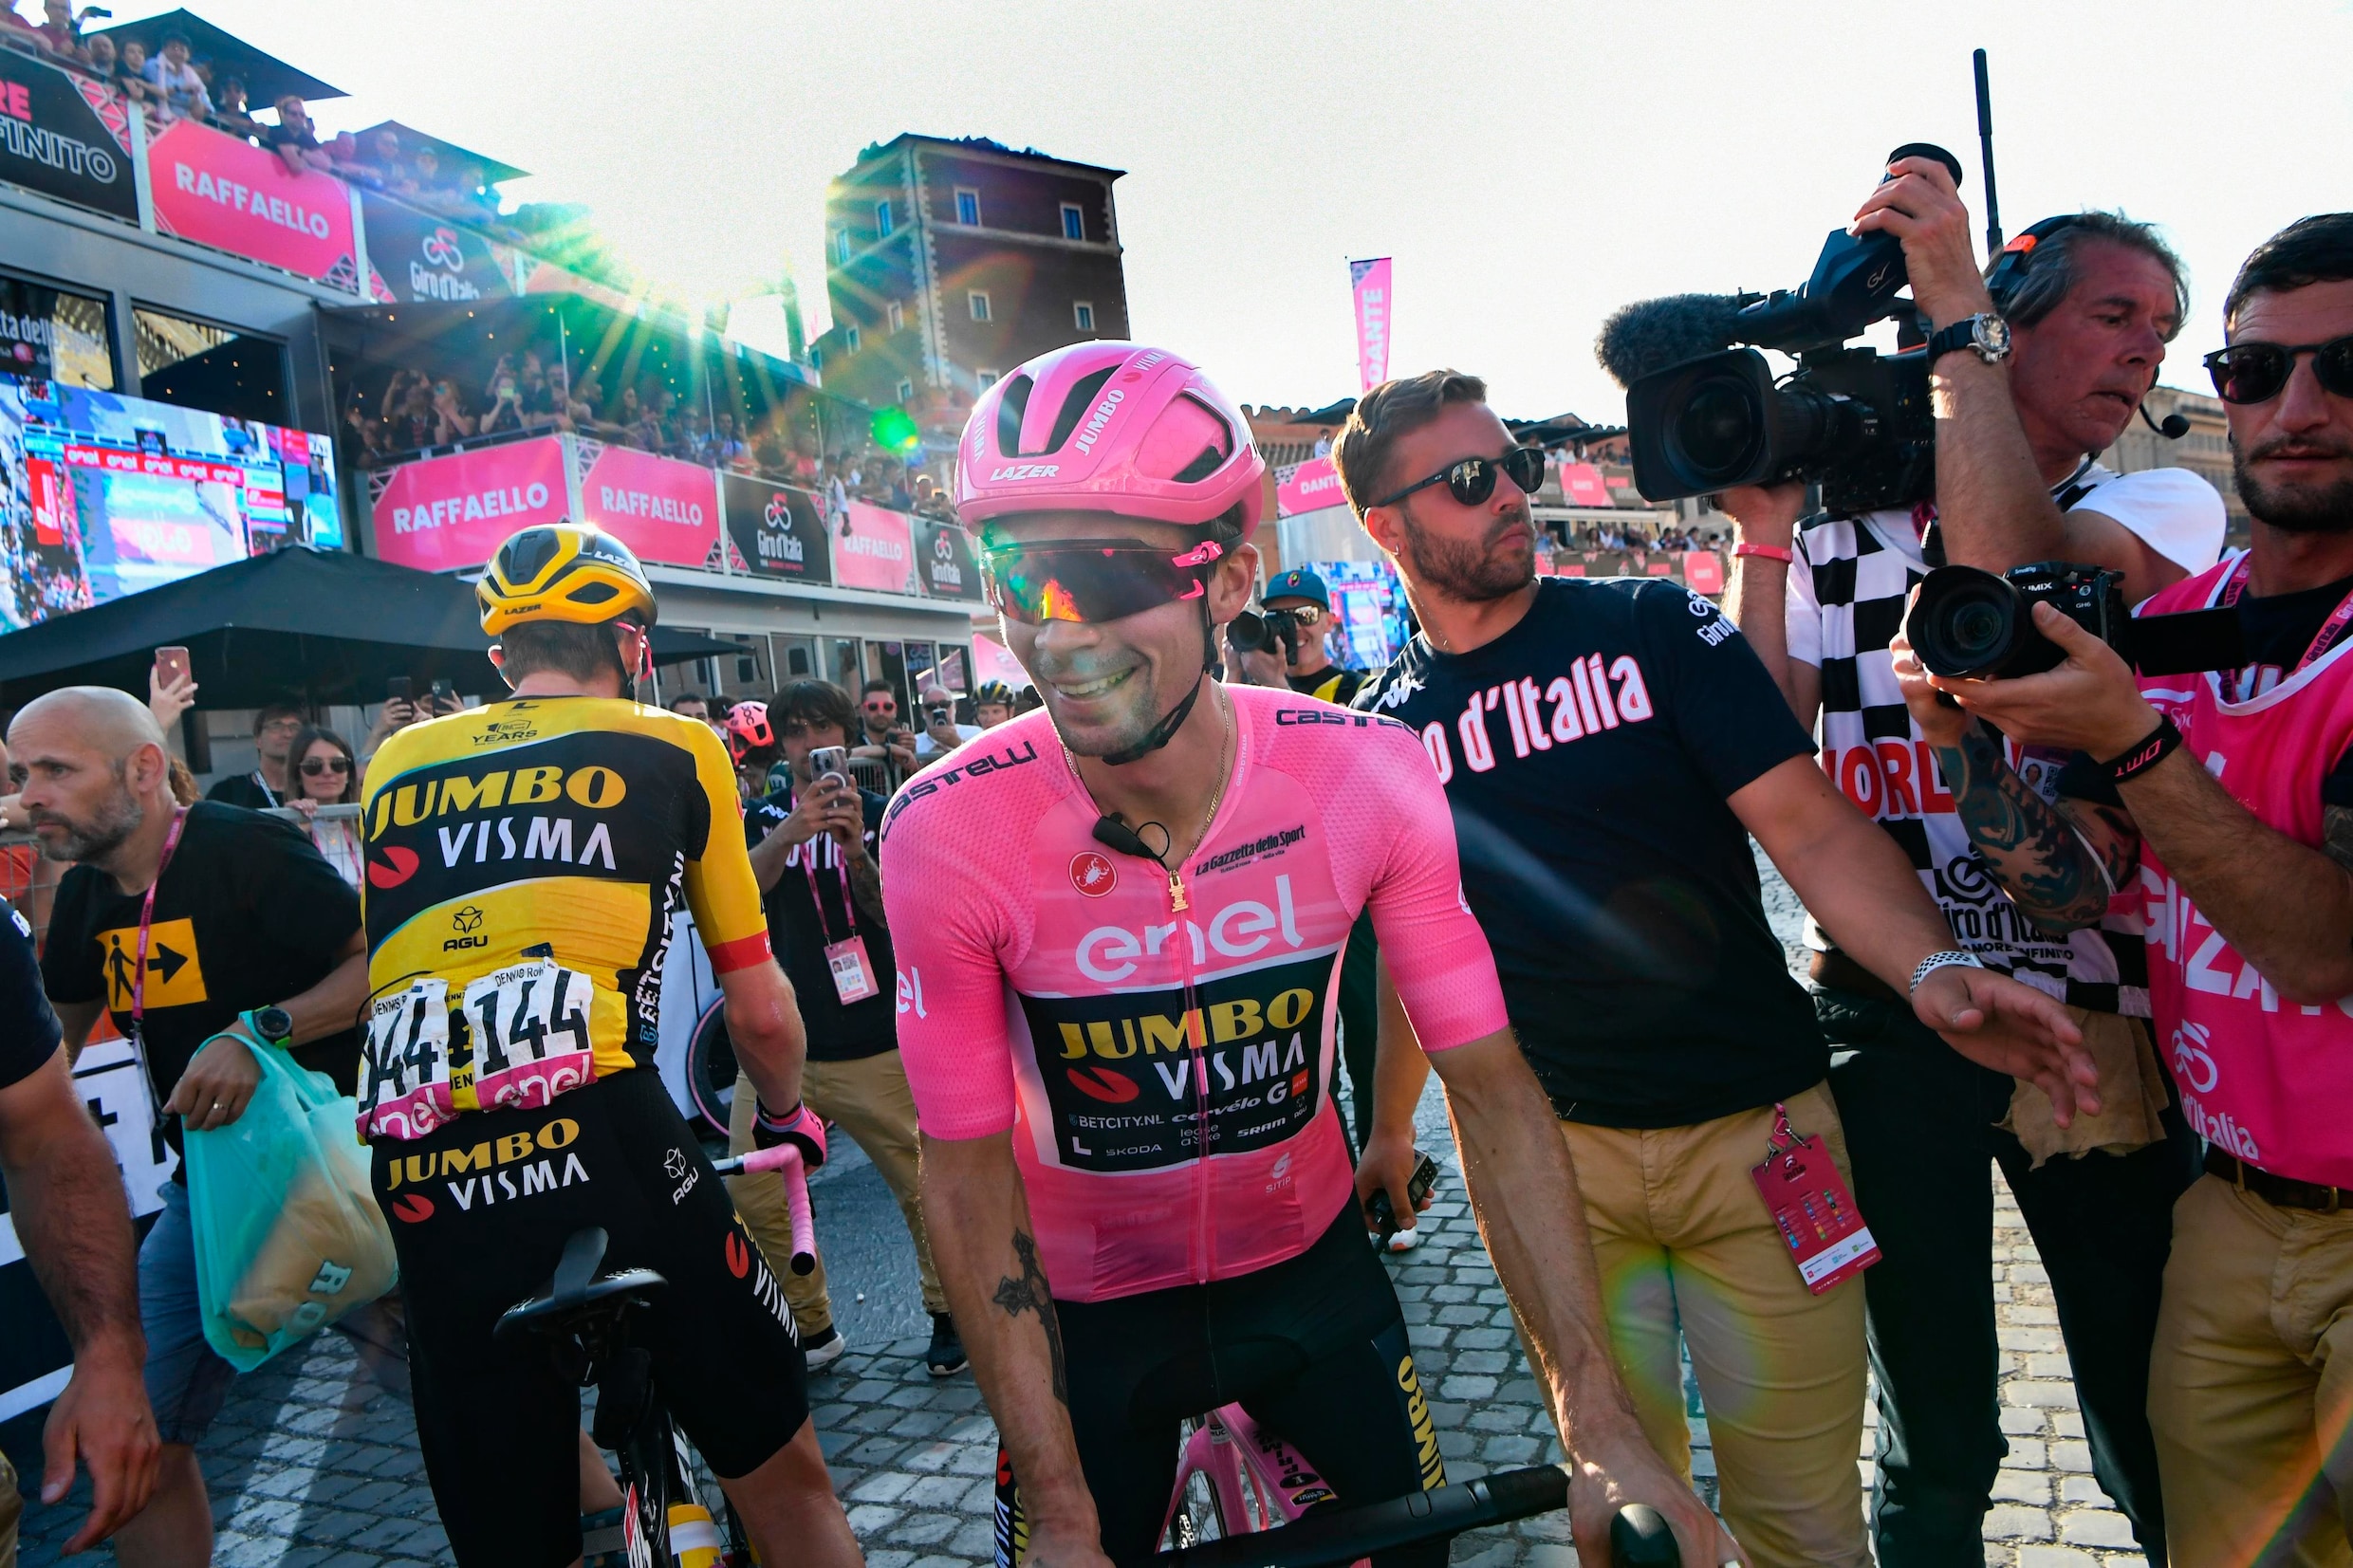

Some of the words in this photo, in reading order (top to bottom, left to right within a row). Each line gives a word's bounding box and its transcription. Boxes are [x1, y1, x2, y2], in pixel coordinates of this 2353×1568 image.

[175, 162, 330, 240] RAFFAELLO
[1133, 351, 1167, 372] VISMA
[1362, 288, 1384, 383] DANTE
[1074, 389, 1126, 456] JUMBO
[990, 464, 1060, 482] LAZER
[393, 482, 549, 535] RAFFAELLO
[601, 486, 703, 527] RAFFAELLO
[757, 529, 776, 557] Giro
[775, 533, 803, 563] d'Italia
[843, 535, 901, 561] RAFFAELLO
[504, 602, 542, 616] LAZER
[472, 729, 538, 744] YEARS
[1458, 652, 1654, 773] d'Italia
[370, 766, 627, 842] JUMBO
[438, 816, 617, 870] VISMA
[1195, 861, 1210, 876] La
[1210, 842, 1255, 870] Gazzetta
[1255, 835, 1279, 854] dello
[1279, 824, 1306, 848] Sport
[443, 934, 489, 952] AGU
[1075, 874, 1305, 983] enel
[1938, 903, 1981, 939] iro
[474, 969, 589, 1076] 144
[1058, 988, 1314, 1060] JUMBO
[494, 1055, 590, 1110] enel
[1153, 1032, 1306, 1100] VISMA
[1267, 1081, 1288, 1104] G
[1294, 1106, 1307, 1119] AGU
[1079, 1114, 1165, 1130] BETCITY.NL
[1237, 1116, 1287, 1137] SRAM
[387, 1118, 580, 1191] JUMBO
[448, 1153, 590, 1211] VISMA
[672, 1167, 699, 1206] AGU
[1266, 1176, 1291, 1193] SITIP
[753, 1257, 799, 1348] VISMA
